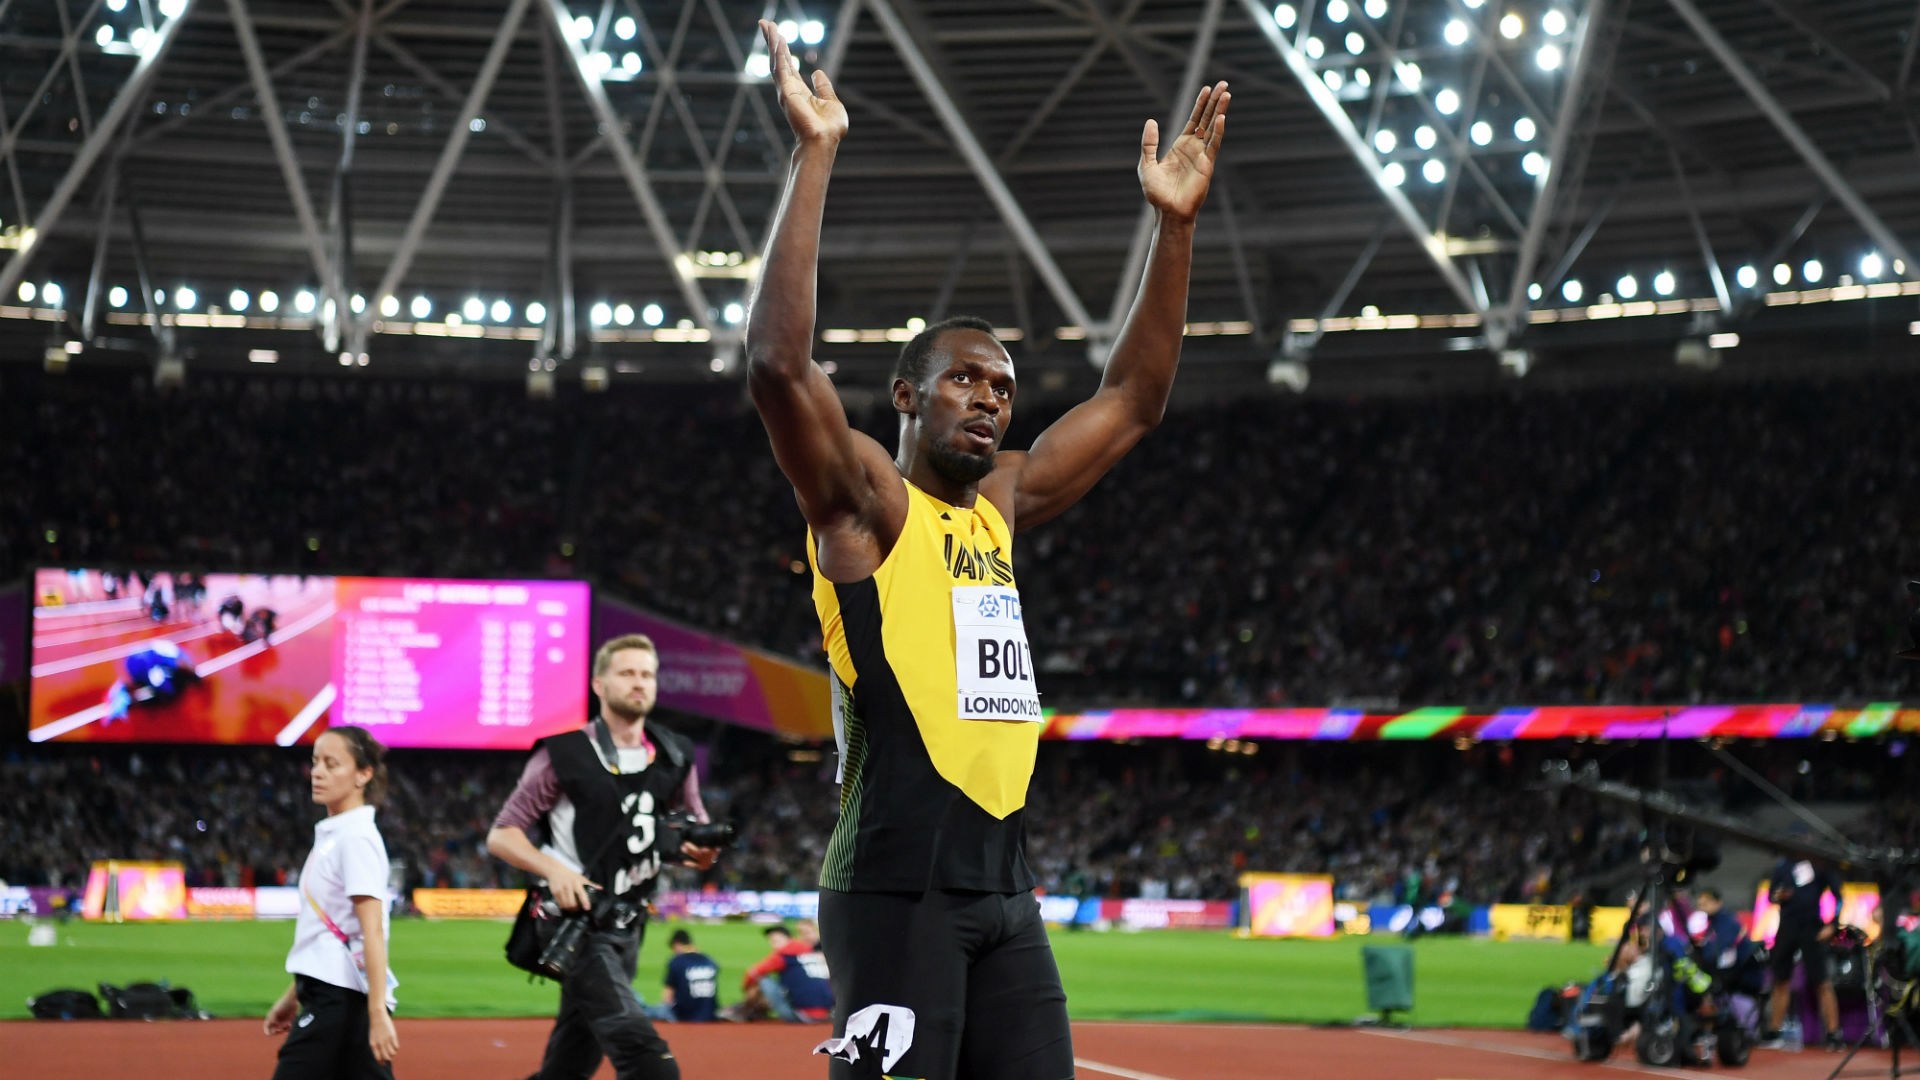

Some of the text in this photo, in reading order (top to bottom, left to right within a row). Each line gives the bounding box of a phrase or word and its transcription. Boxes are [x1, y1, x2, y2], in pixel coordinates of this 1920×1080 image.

[1000, 594, 1021, 620] TD
[964, 696, 1027, 715] LONDON
[864, 1012, 890, 1066] 4
